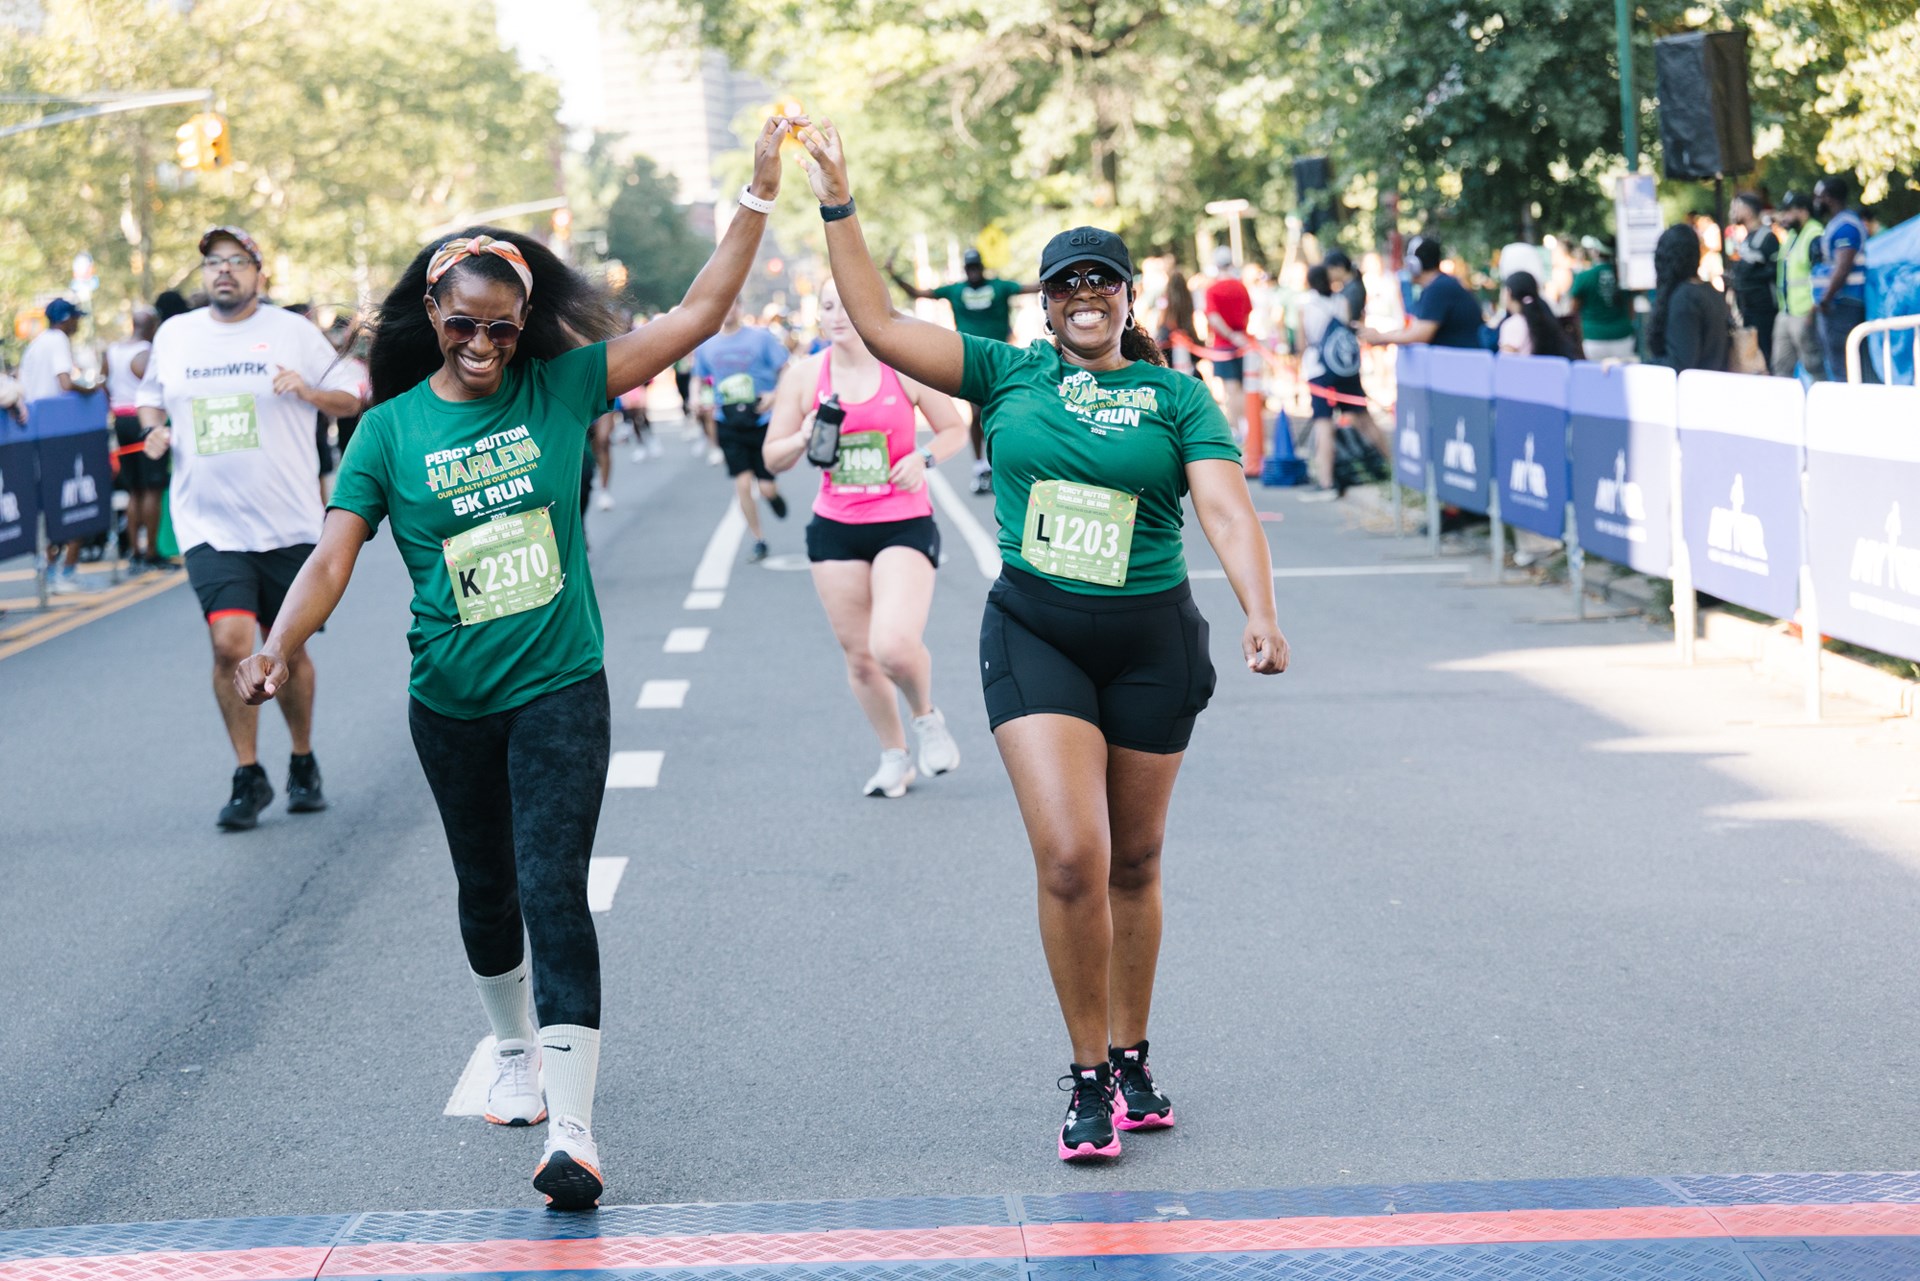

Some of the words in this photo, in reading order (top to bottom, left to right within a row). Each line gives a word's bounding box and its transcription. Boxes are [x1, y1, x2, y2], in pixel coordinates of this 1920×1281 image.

[1070, 232, 1100, 246] alo
[186, 362, 268, 379] teamWRK
[1095, 408, 1140, 427] RUN
[424, 446, 472, 467] PERCY
[474, 424, 530, 453] SUTTON
[427, 437, 541, 492] HARLEM
[437, 488, 454, 500] OUR
[454, 482, 484, 496] HEALTH
[484, 479, 492, 487] IS
[492, 474, 508, 485] OUR
[508, 462, 538, 478] WEALTH
[451, 492, 485, 516] 5K
[484, 475, 534, 506] RUN
